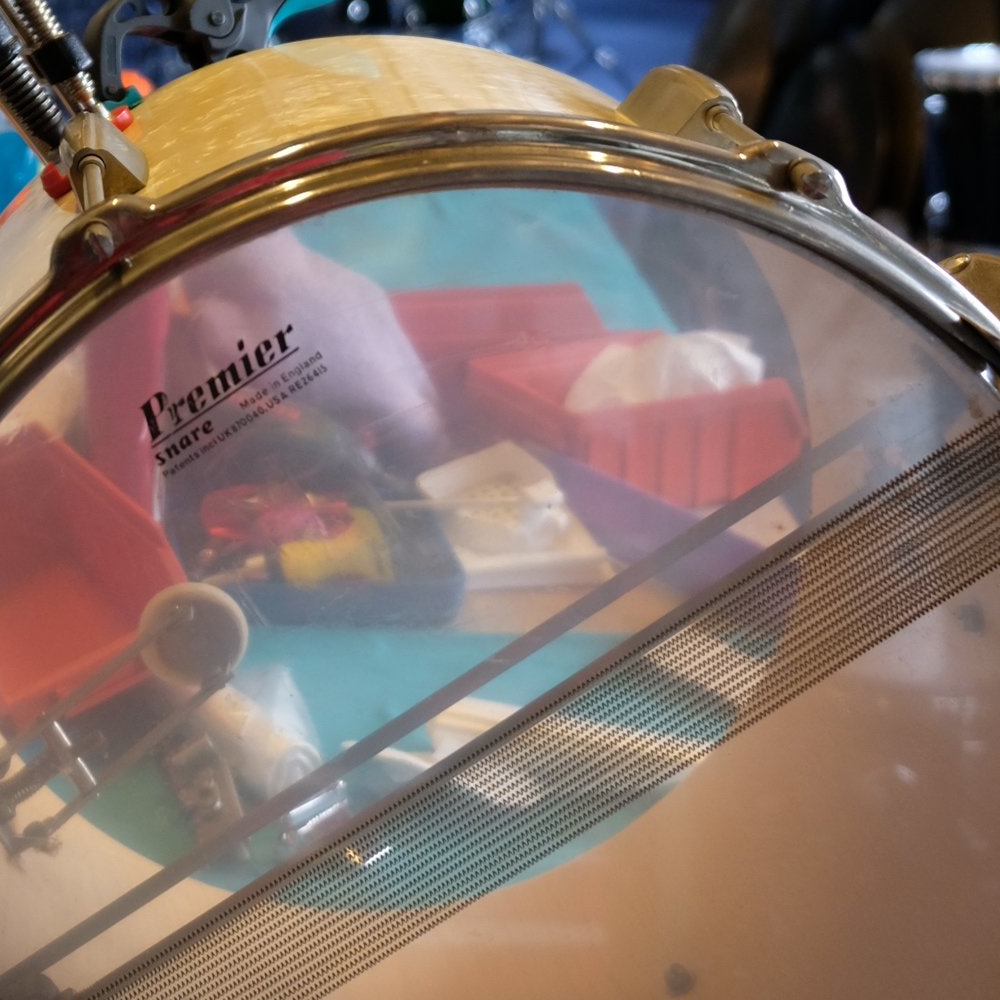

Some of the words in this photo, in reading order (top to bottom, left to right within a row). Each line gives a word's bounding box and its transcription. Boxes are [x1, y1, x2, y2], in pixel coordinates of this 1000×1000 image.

[140, 324, 293, 441] Premier
[239, 388, 269, 409] Made
[271, 380, 281, 391] in
[281, 352, 323, 383] England
[155, 420, 214, 466] snare
[163, 453, 200, 479] Patents
